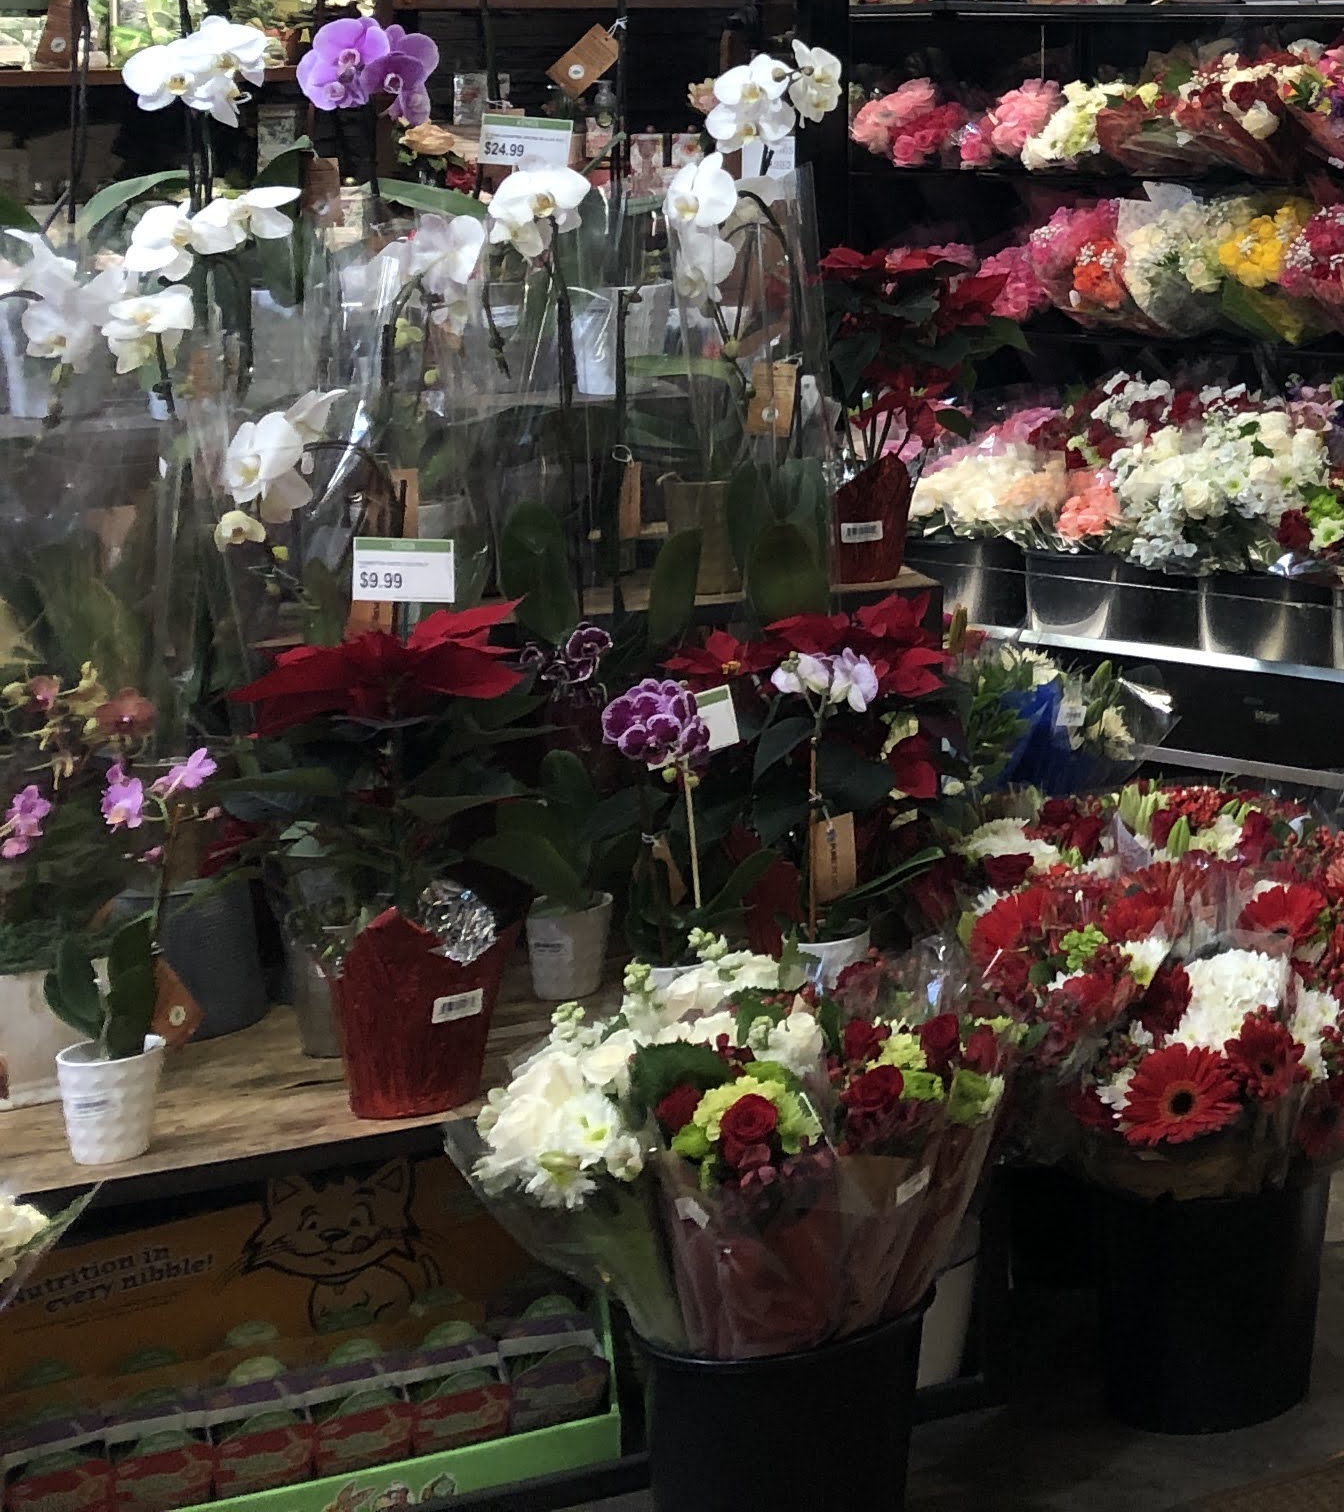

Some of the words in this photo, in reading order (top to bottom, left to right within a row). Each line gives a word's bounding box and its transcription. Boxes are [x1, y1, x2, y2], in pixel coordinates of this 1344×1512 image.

[484, 141, 525, 157] $24.99
[359, 571, 403, 589] $9.99
[142, 1246, 170, 1264] in
[46, 1280, 114, 1313] every
[121, 1253, 214, 1290] nibble!
